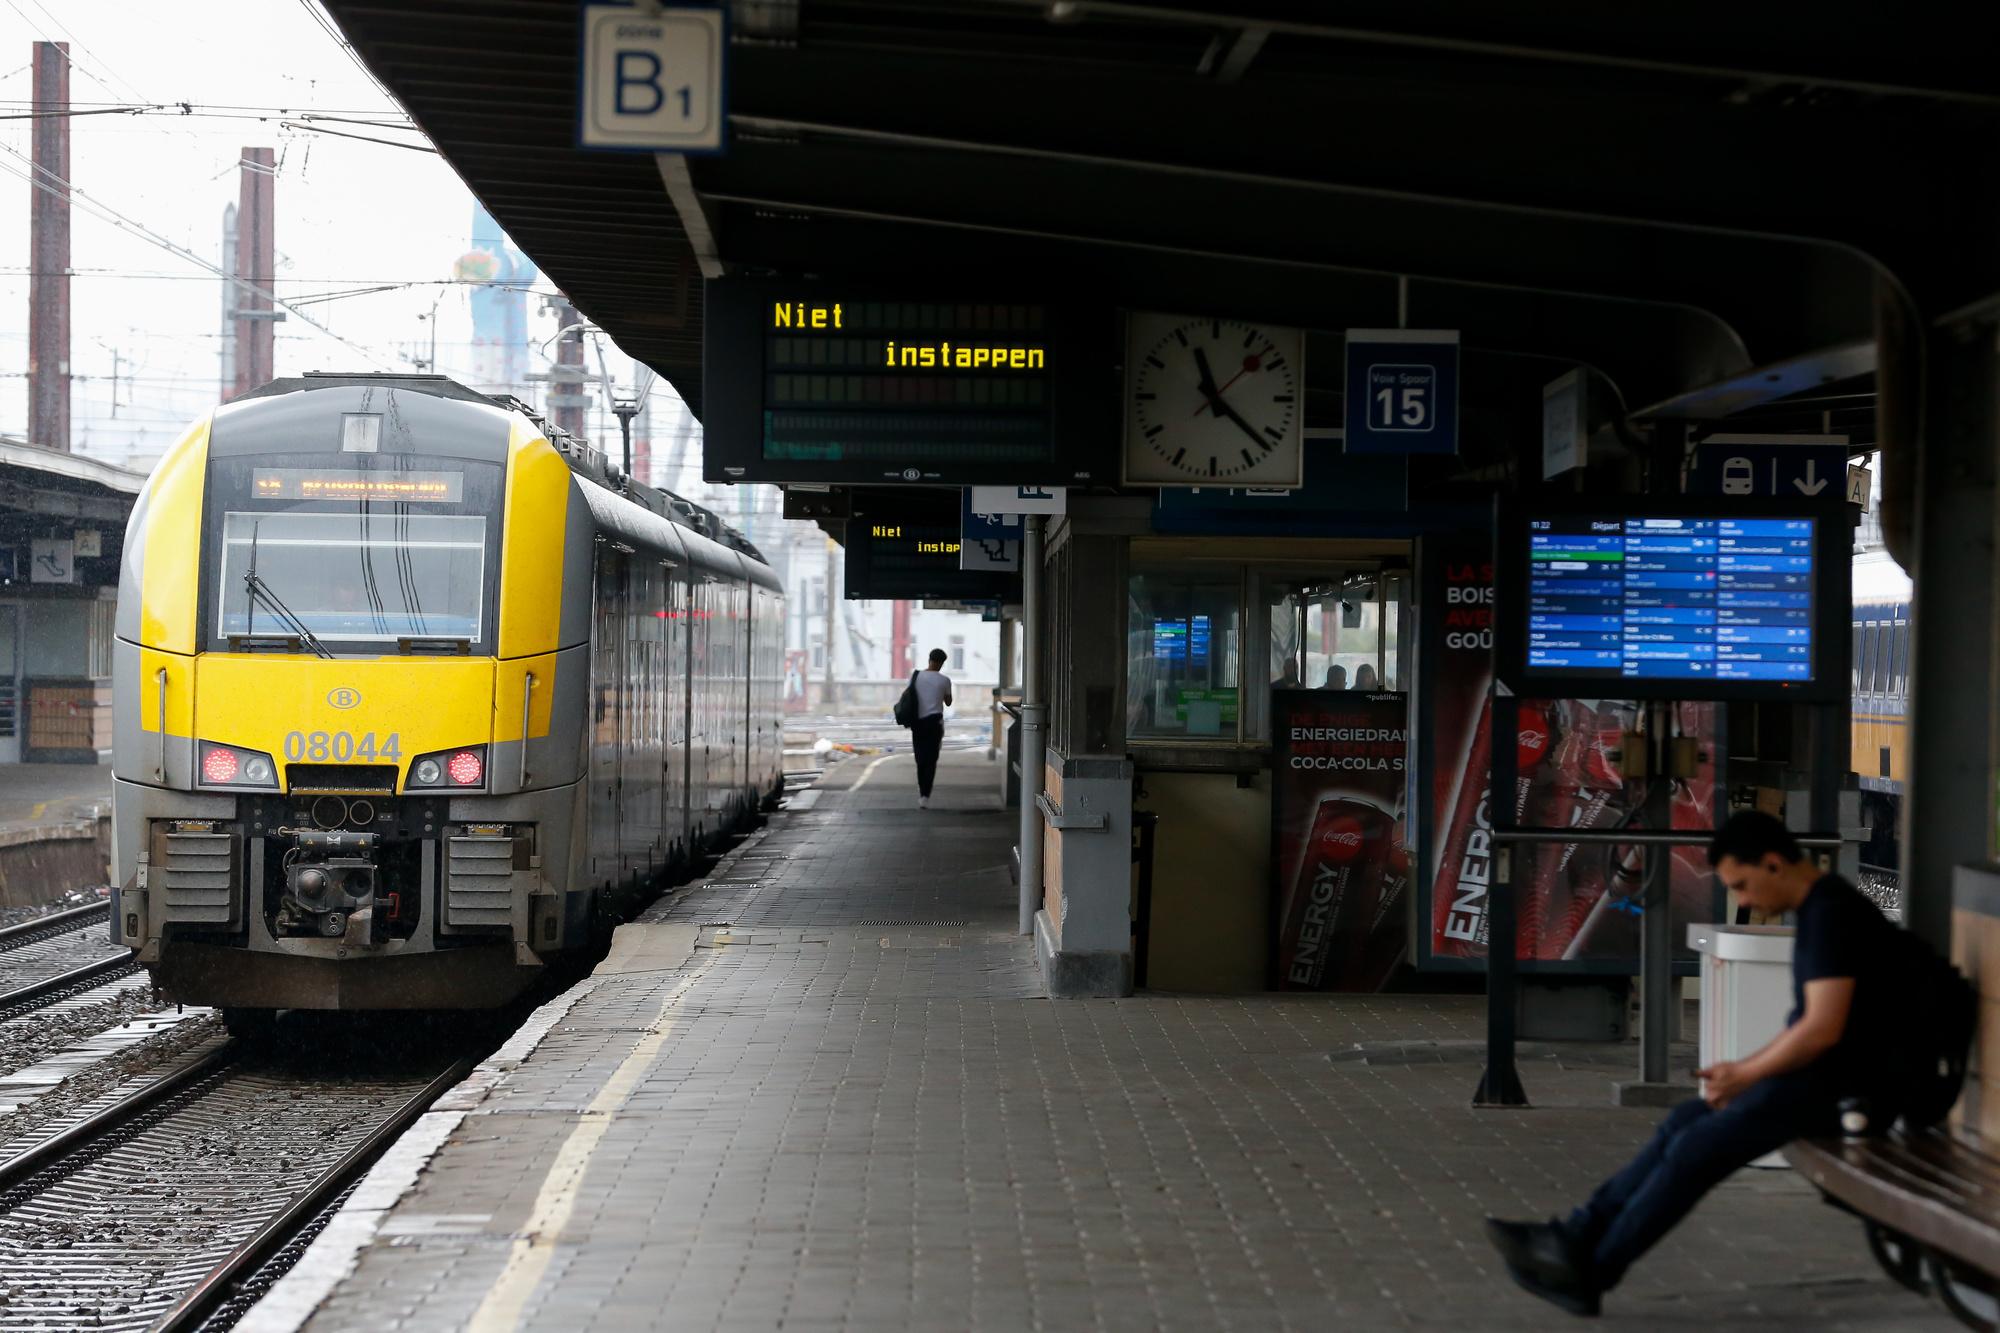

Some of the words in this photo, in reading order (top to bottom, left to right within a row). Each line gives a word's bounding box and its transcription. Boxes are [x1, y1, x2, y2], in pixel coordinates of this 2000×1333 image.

[774, 303, 843, 328] Niet
[886, 341, 1044, 368] instappen
[1372, 372, 1396, 384] Voie
[1399, 372, 1431, 385] Spoor
[1376, 388, 1425, 425] 15
[872, 526, 901, 537] Niet
[1446, 563, 1476, 582] LA
[1446, 586, 1494, 604] BOIS
[1446, 627, 1494, 649] GOÛ
[284, 731, 402, 763] 08044
[1288, 862, 1338, 984] ENERGY
